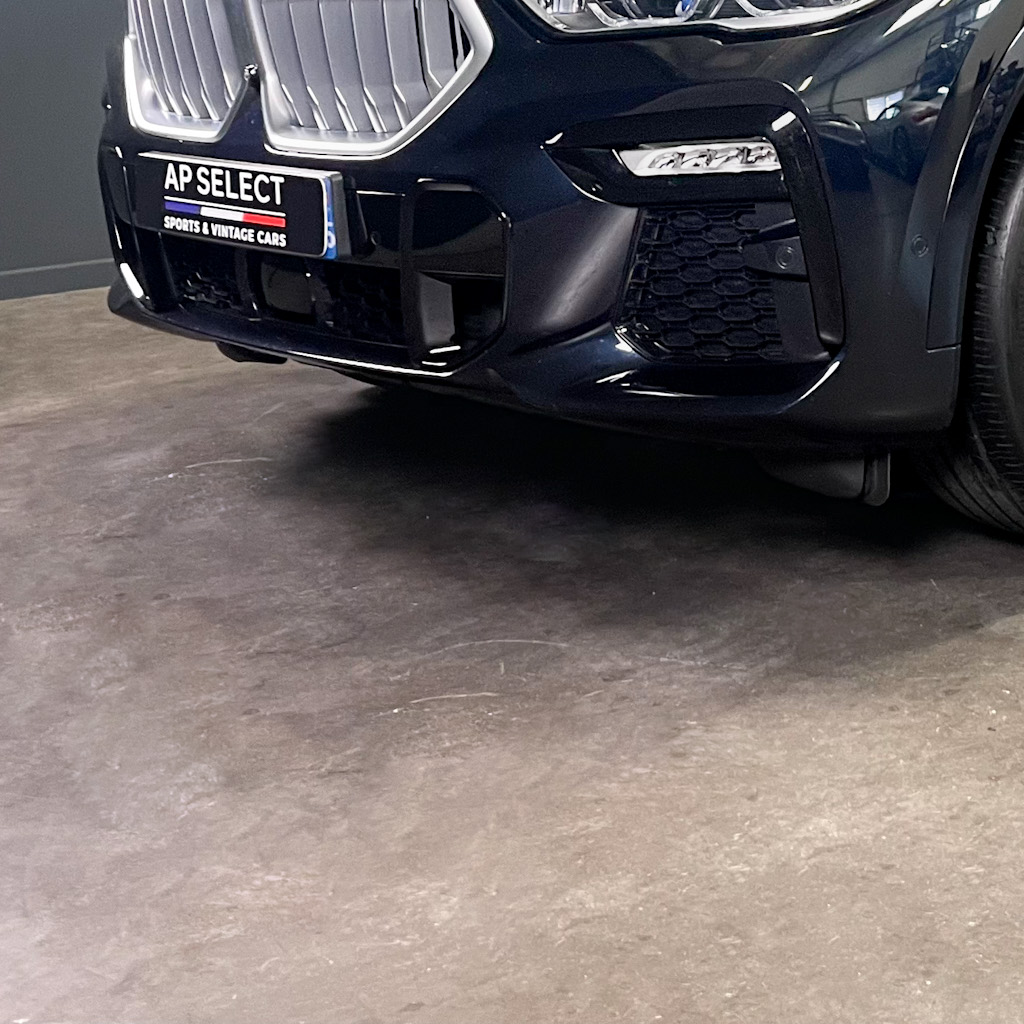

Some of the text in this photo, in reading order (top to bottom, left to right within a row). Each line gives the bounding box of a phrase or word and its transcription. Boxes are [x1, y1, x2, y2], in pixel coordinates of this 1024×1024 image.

[164, 162, 285, 206] AP SELECT
[163, 215, 287, 248] SPORTS & VINTAGE CARS
